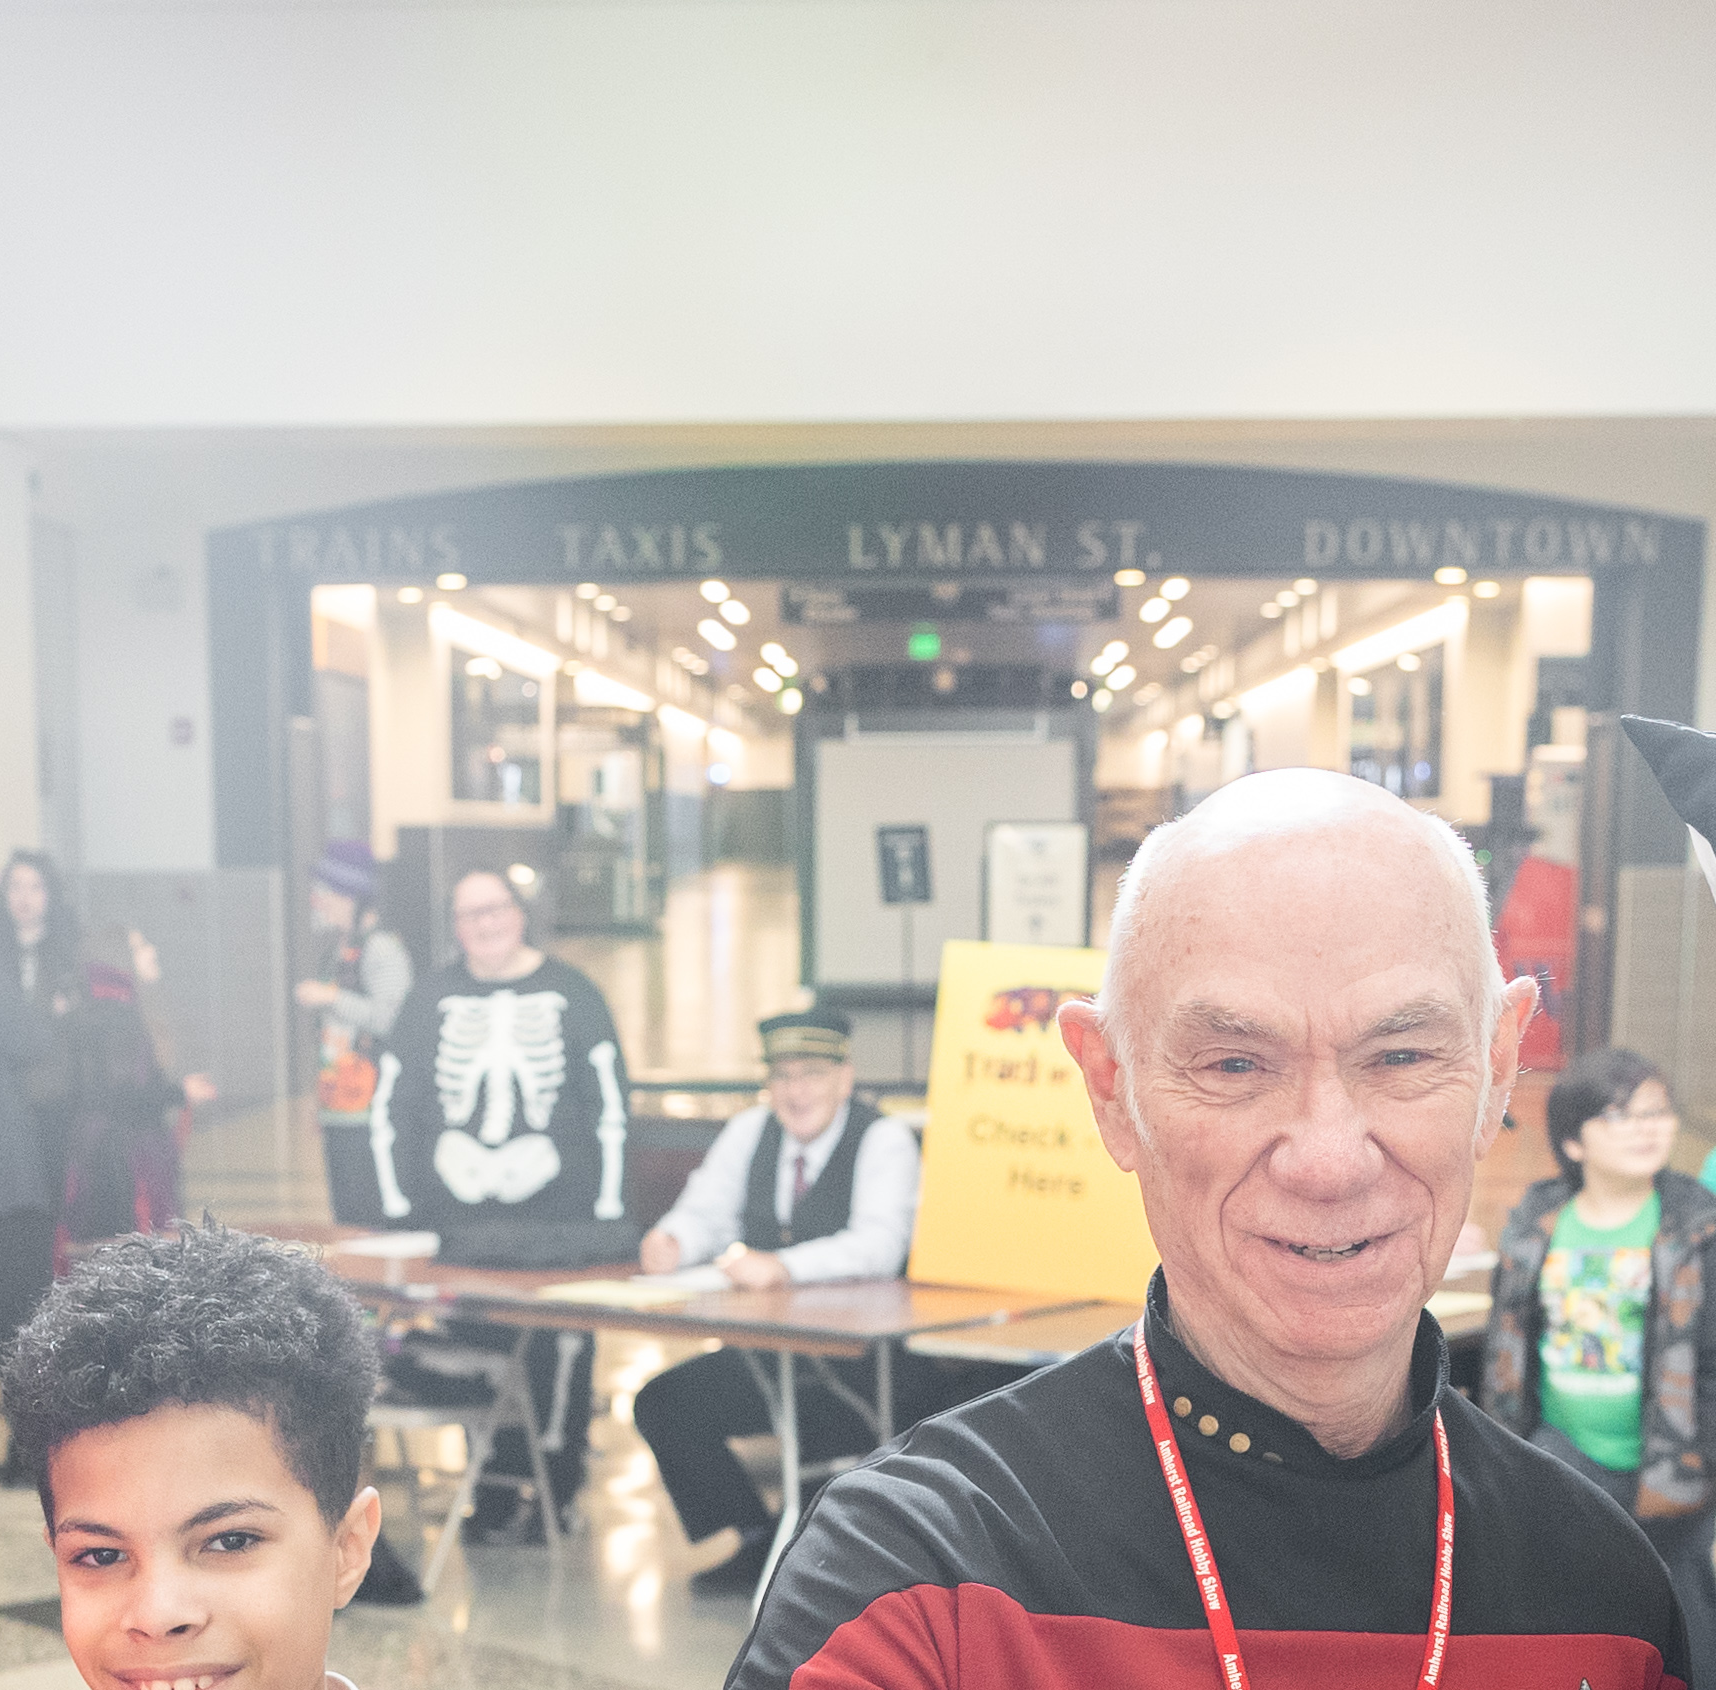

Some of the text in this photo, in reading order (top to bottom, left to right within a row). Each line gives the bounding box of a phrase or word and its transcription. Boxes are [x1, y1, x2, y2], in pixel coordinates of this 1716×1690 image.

[256, 519, 1662, 571] TRAINS TAXIS LYMAN ST. DOWNTOWN
[1008, 1165, 1084, 1197] Here
[1141, 1376, 1156, 1405] Show
[1158, 1439, 1221, 1610] Amherst Railroad Hobby Show
[1424, 1511, 1453, 1686] Amherst Railroad Hobby Show
